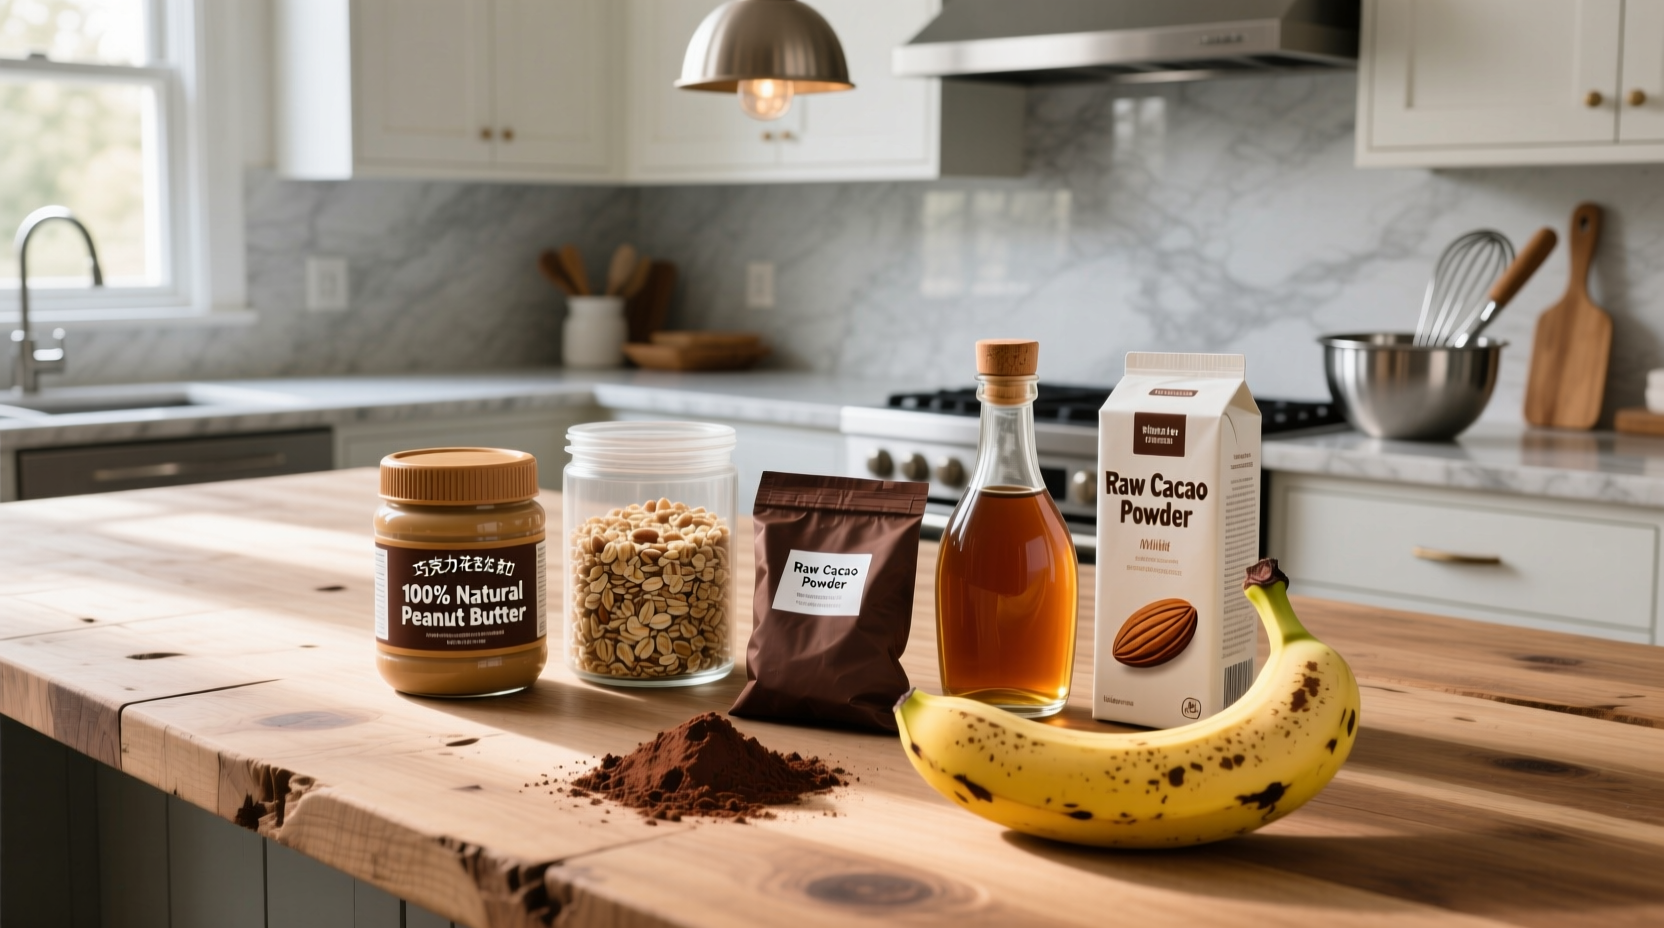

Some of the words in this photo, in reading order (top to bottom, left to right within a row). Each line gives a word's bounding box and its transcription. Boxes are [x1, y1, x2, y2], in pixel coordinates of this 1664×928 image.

[1105, 470, 1146, 496] Raw
[1150, 472, 1208, 501] Cacao
[1120, 499, 1193, 528] Powder
[793, 561, 819, 574] Raw
[823, 564, 858, 576] Cacao
[402, 583, 450, 605] 100%
[456, 580, 523, 605] Natural
[801, 576, 847, 589] Powder
[402, 605, 465, 627] Peanut
[470, 606, 526, 626] Butter
